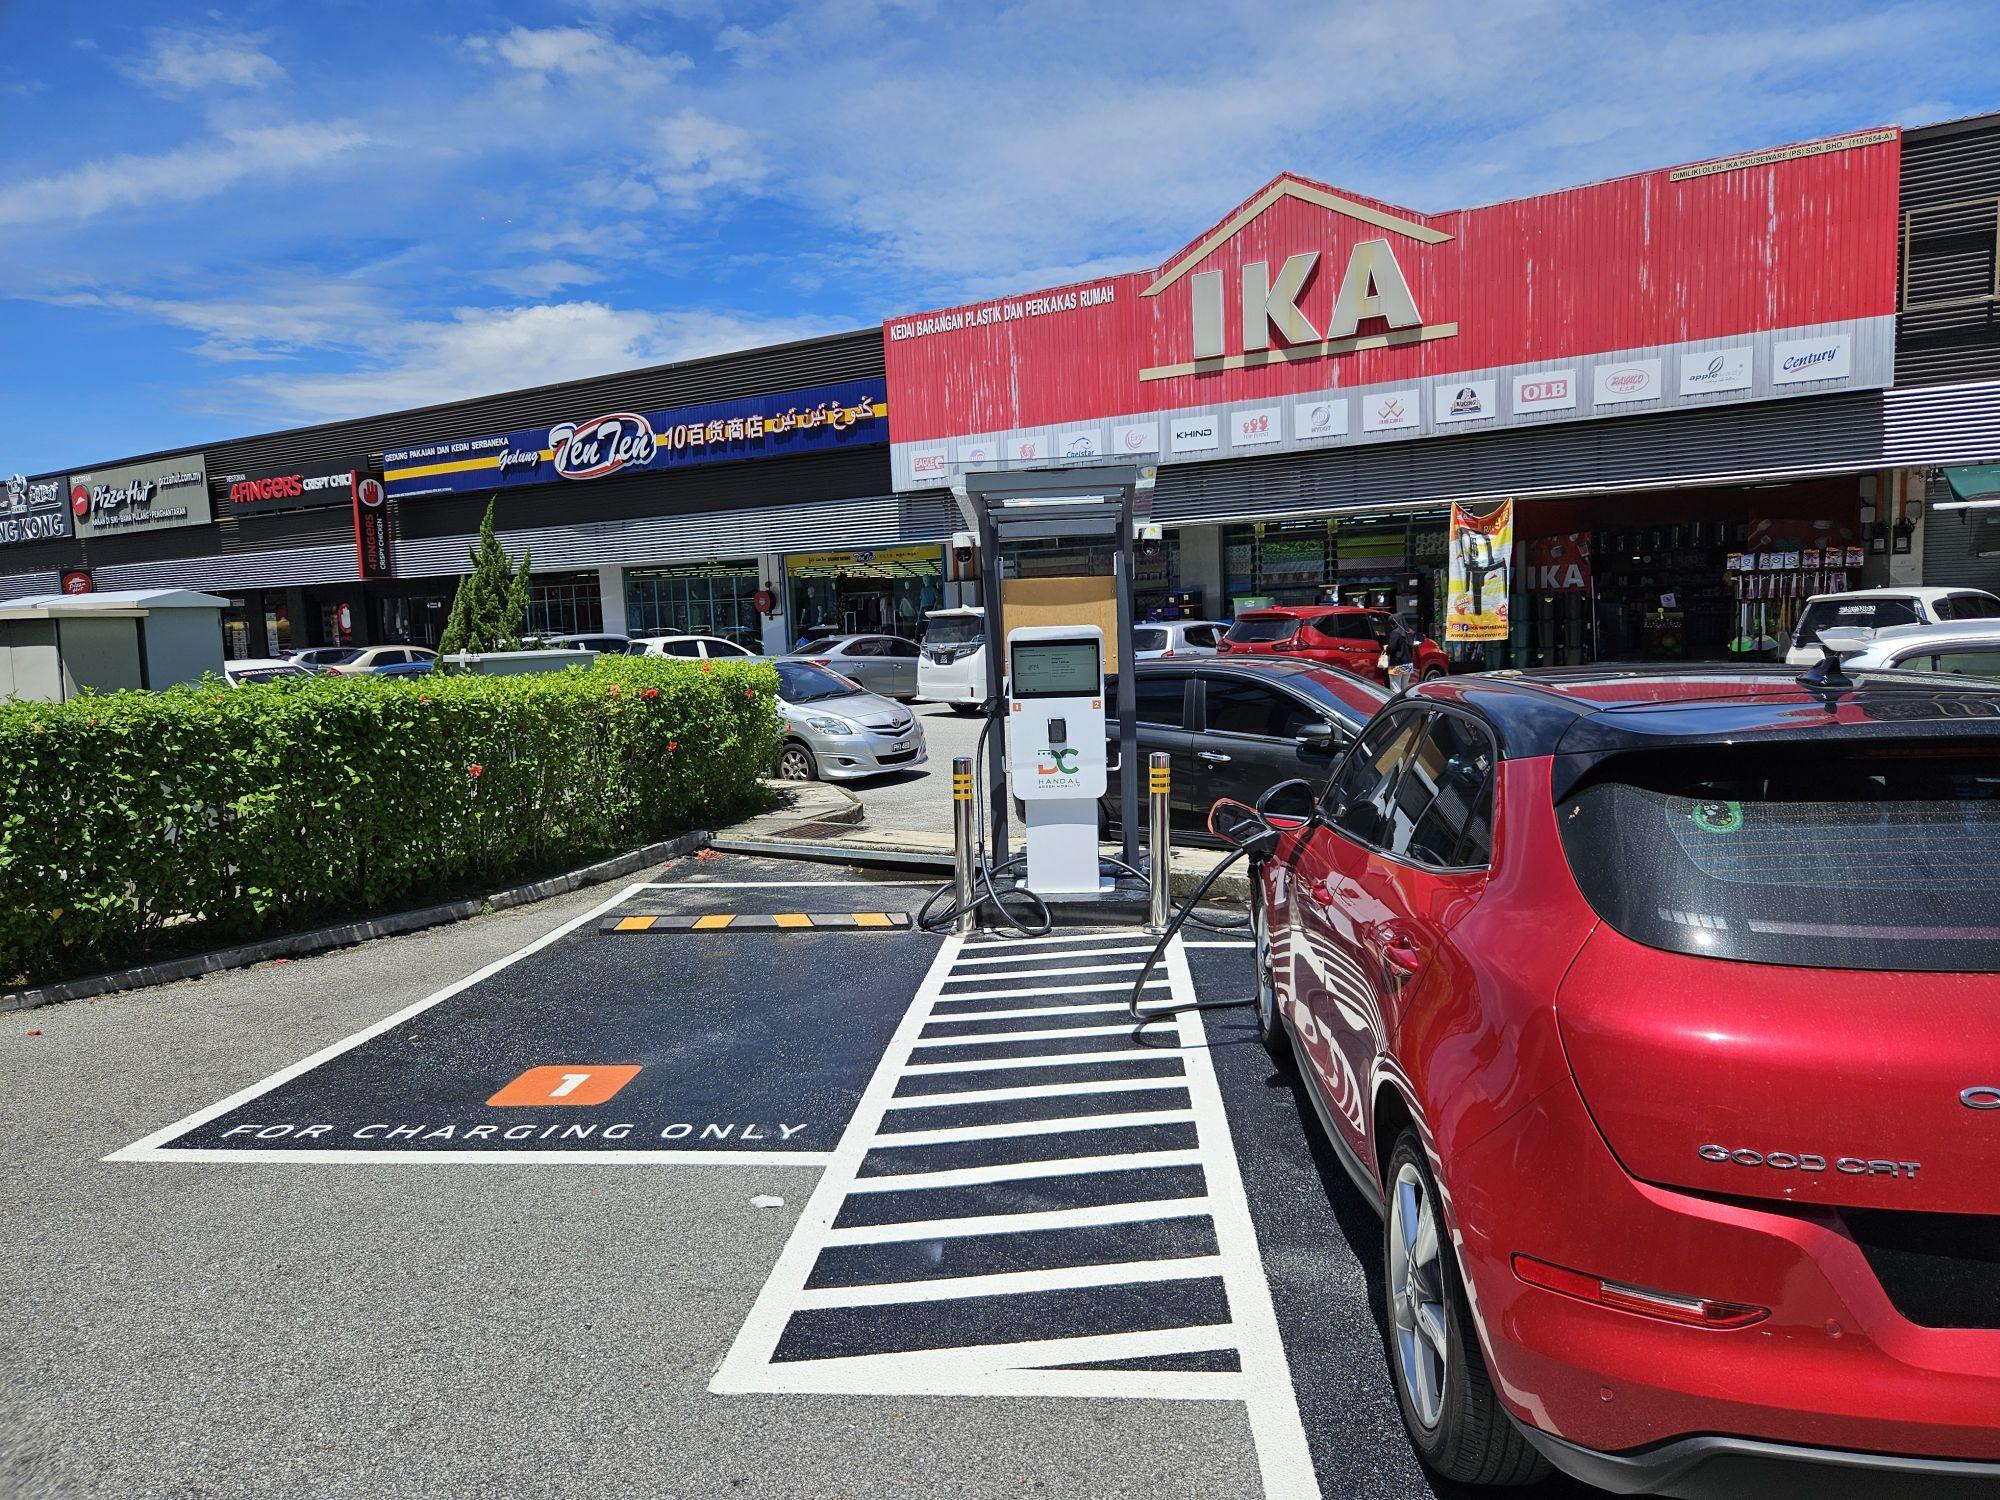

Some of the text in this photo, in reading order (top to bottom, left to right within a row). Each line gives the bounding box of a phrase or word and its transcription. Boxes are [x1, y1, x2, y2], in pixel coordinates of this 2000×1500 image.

[1672, 168, 1701, 180] DIMILIKI
[1703, 164, 1724, 175] OLEH:
[1725, 161, 1738, 170] IKA
[1739, 151, 1788, 168] HOUSEWARE
[1788, 148, 1804, 160] (PS)
[1805, 145, 1824, 156] SDN.
[1825, 141, 1845, 153] BHD.
[1191, 238, 1423, 359] IKA
[890, 285, 1115, 342] KEDAI BARANGAN PLASTIK DAN PERKAKAS RUMAH
[1783, 348, 1837, 371] Century
[1523, 382, 1567, 400] OLB
[498, 421, 651, 472] Gedung Ten Ten
[1176, 428, 1212, 440] KHIND
[384, 437, 509, 462] GEDUNG PAKAIAN DAN KEDAI SERBANEKA
[914, 457, 935, 468] EAGLE
[158, 471, 202, 487] pizzahut.com.my
[303, 476, 330, 491] CRISPY
[91, 480, 155, 512] Pizza Hut
[151, 506, 187, 519] PENGHANTARAN
[19, 513, 64, 541] KONG
[69, 582, 86, 591] Pizza
[1527, 563, 1585, 589] IKA
[547, 1073, 593, 1098] 1
[220, 1123, 808, 1140] FOR CHARGING ONLY
[1698, 1144, 1921, 1179] GOOD CAT
